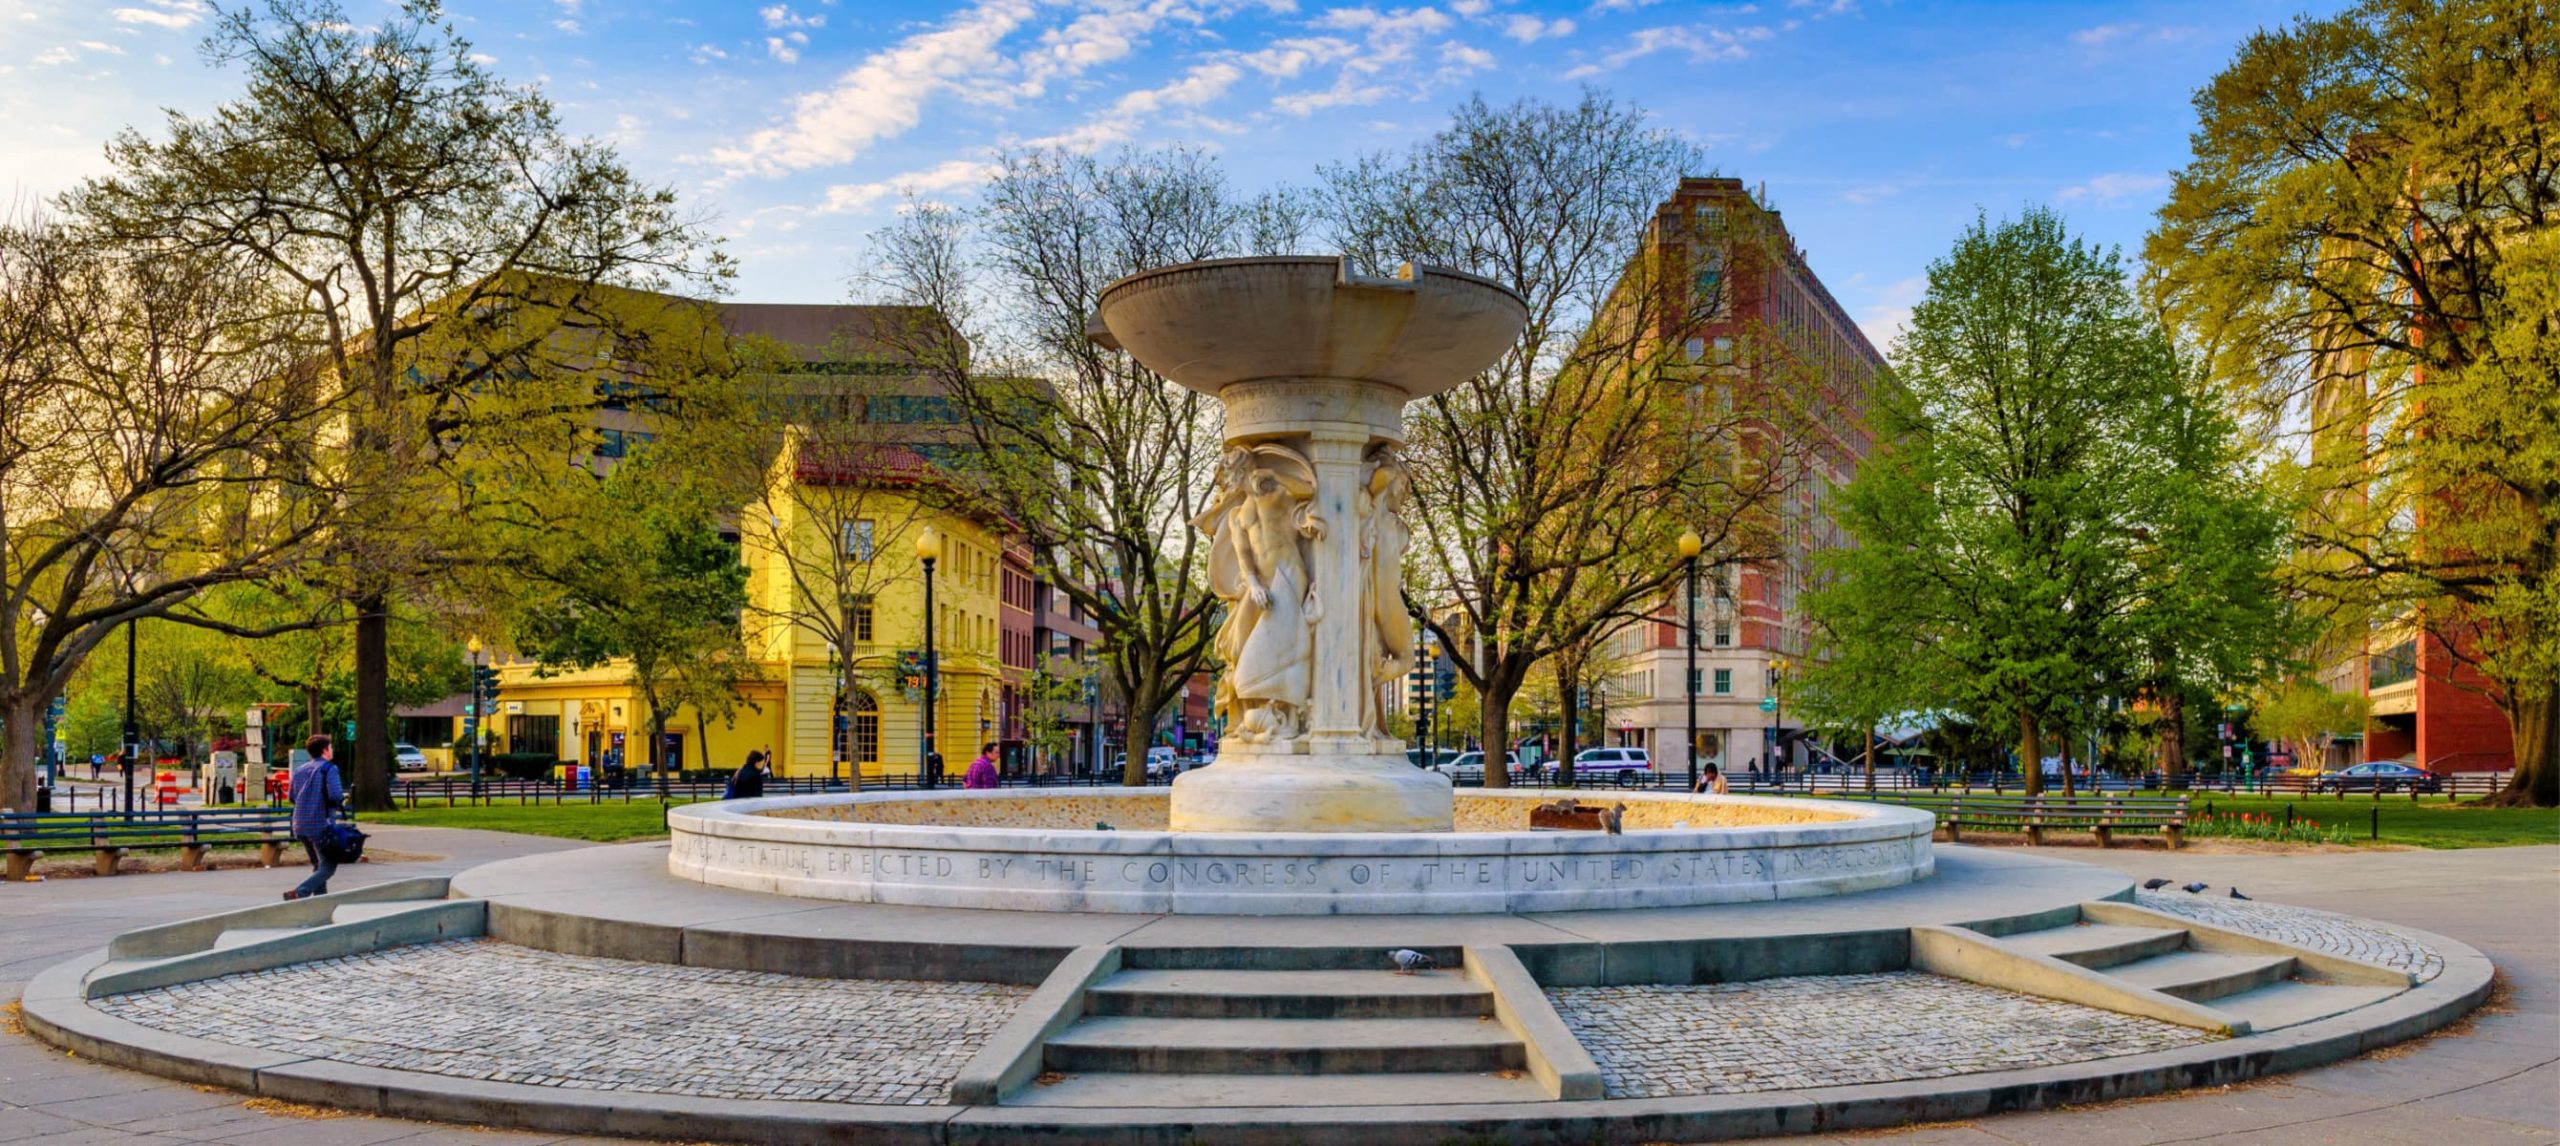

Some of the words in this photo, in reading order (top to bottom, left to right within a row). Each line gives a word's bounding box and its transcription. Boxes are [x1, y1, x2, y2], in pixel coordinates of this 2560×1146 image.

[738, 845, 810, 869] STATUE
[828, 851, 953, 878] ERECTED
[979, 858, 1014, 879] BY
[1036, 859, 1096, 882] THE
[1122, 861, 1318, 885] CONGRESS
[1350, 863, 1391, 885] OF
[1423, 862, 1490, 884] THE
[1522, 859, 1644, 883] UNITED
[1671, 854, 1765, 878] STATES
[1784, 852, 1805, 874] IN
